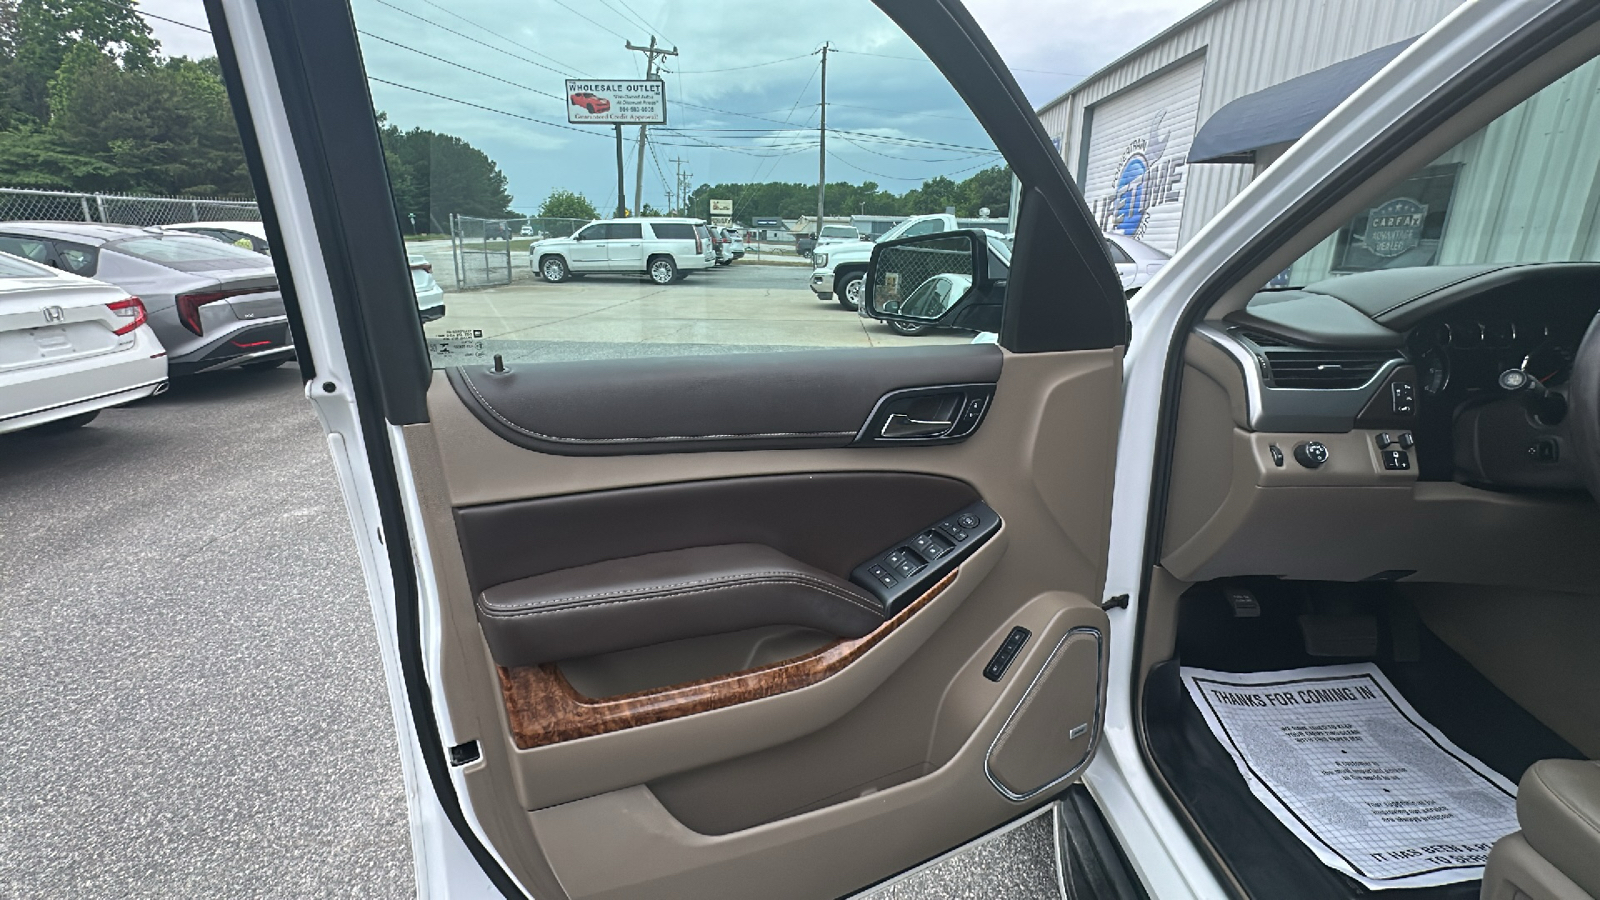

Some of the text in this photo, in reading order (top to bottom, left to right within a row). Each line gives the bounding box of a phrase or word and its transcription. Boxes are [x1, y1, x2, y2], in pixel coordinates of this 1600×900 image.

[569, 84, 661, 92] WHOLESALE OUTLET
[1376, 241, 1404, 251] DEALER
[1211, 685, 1377, 707] THANKS FOR COMING IN
[1370, 852, 1388, 862] IT
[1387, 848, 1423, 860] HAS
[1420, 844, 1464, 854] BEEN
[1462, 844, 1476, 852] A
[1425, 854, 1452, 865] TO
